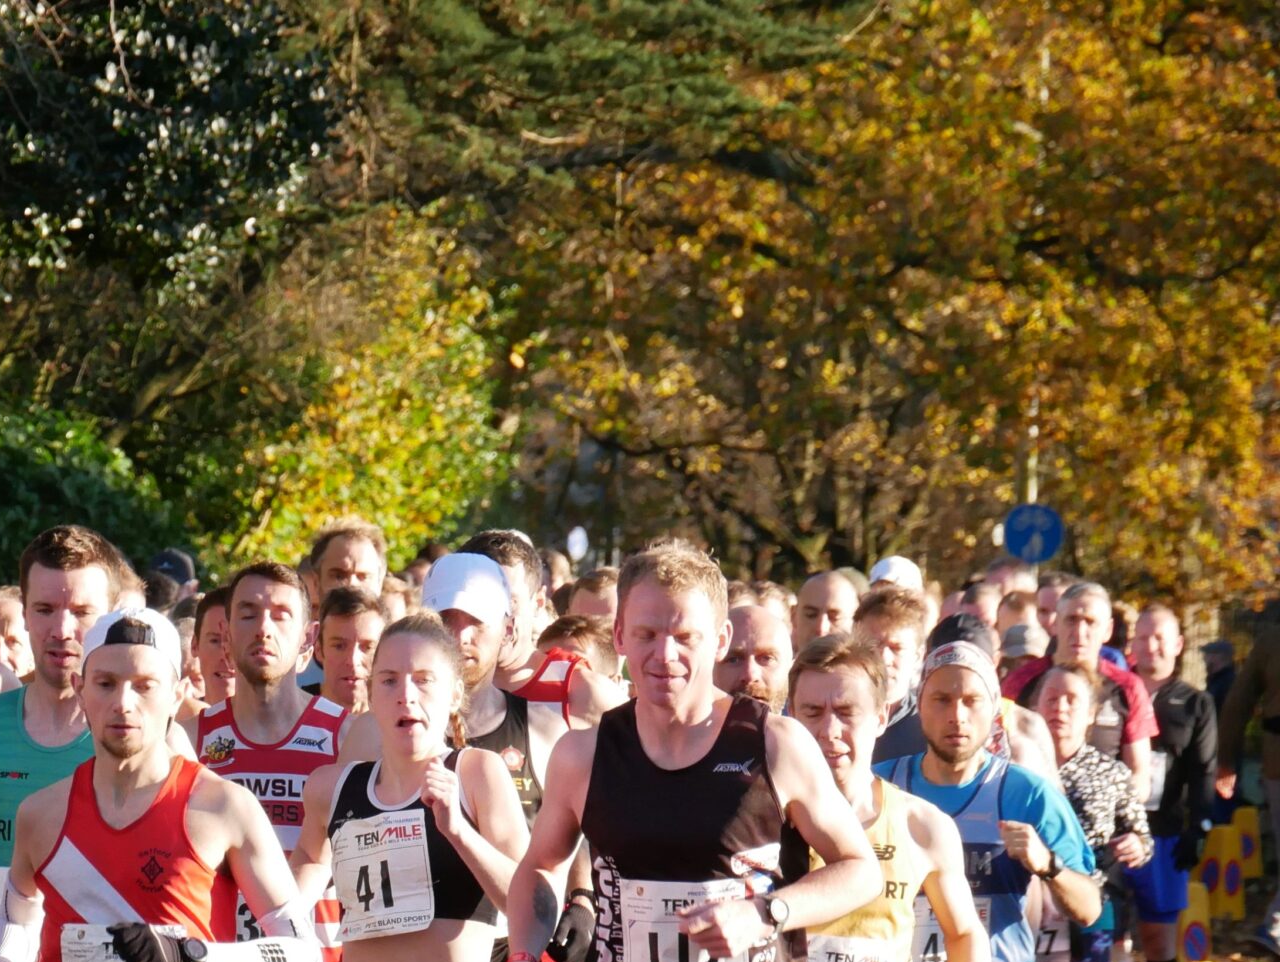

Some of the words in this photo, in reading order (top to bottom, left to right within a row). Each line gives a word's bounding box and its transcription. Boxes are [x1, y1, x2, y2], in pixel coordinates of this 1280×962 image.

[231, 779, 305, 797] WSL
[354, 830, 380, 847] TEN
[380, 824, 423, 842] MILE
[356, 859, 395, 913] 41
[661, 898, 695, 912] TEN
[377, 917, 403, 927] BLAND
[403, 914, 431, 923] SPORTS
[610, 921, 623, 940] by
